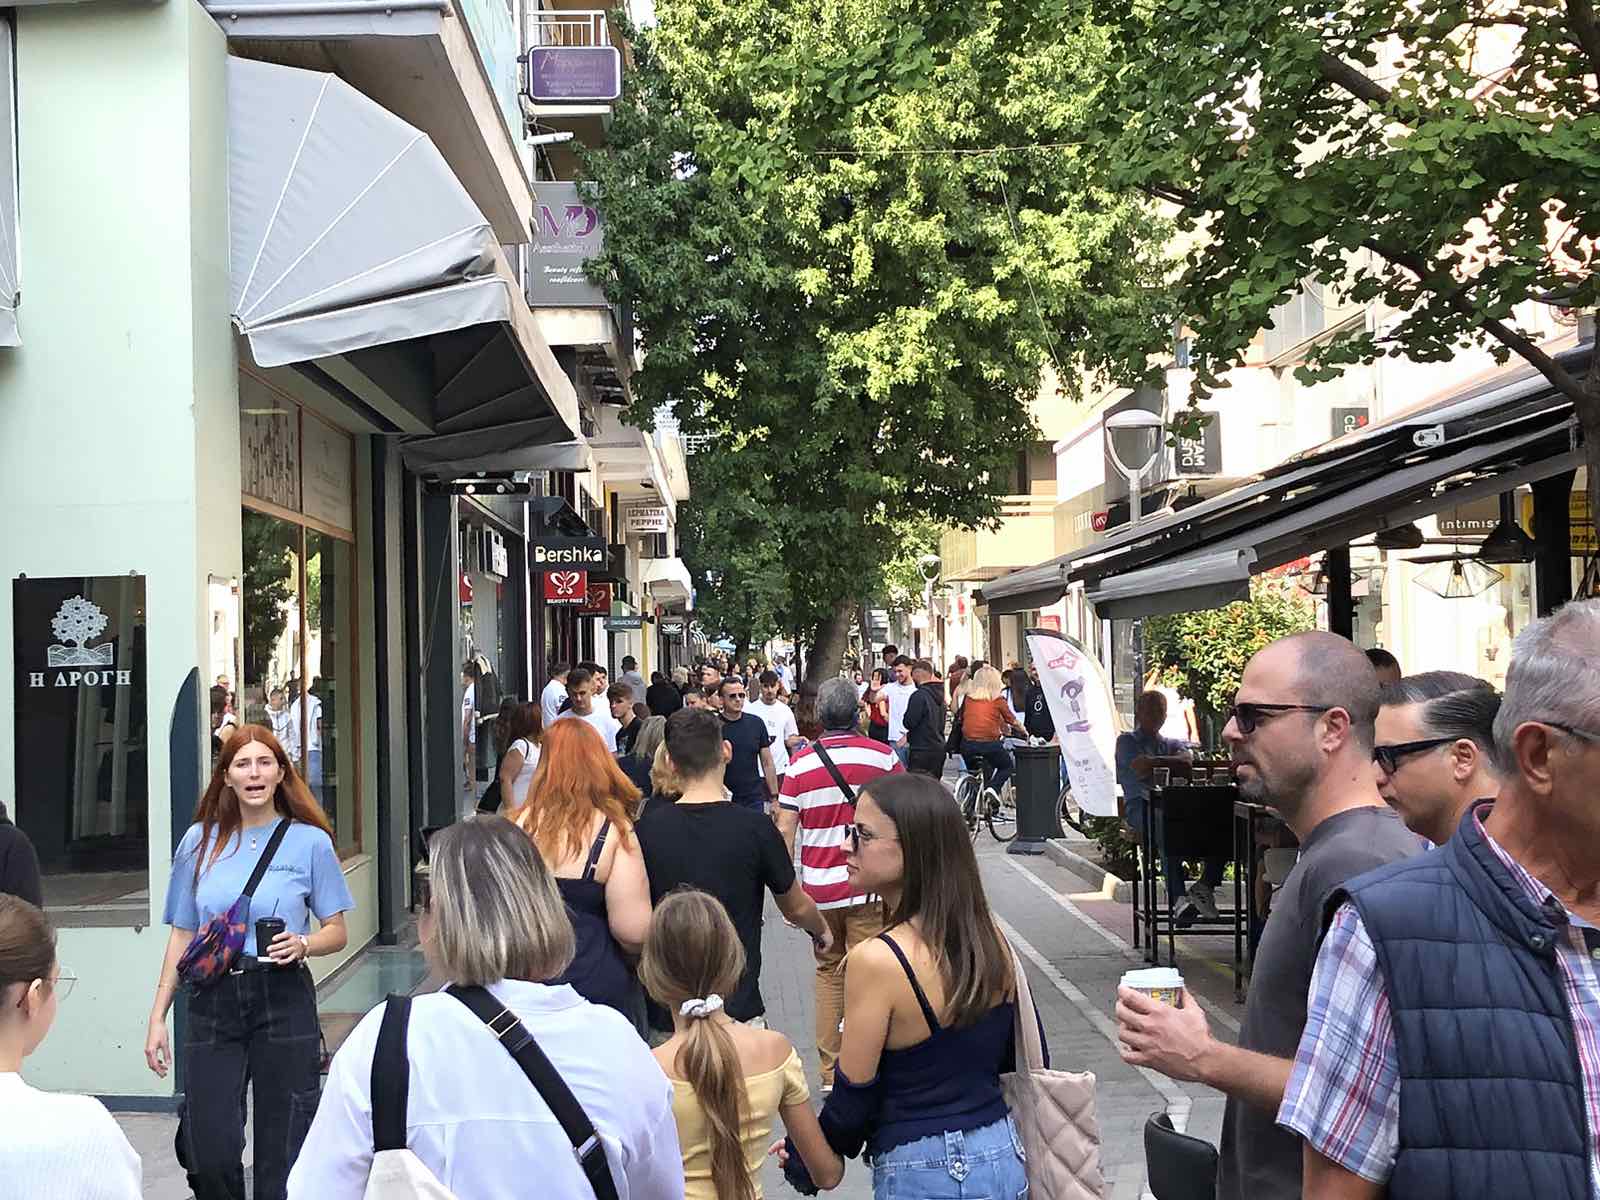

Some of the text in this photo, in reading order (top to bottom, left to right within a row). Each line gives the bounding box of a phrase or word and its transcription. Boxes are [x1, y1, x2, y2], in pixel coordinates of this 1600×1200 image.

[535, 546, 603, 563] Bershka
[29, 670, 132, 688] Η ΔΡΟΓΗ
